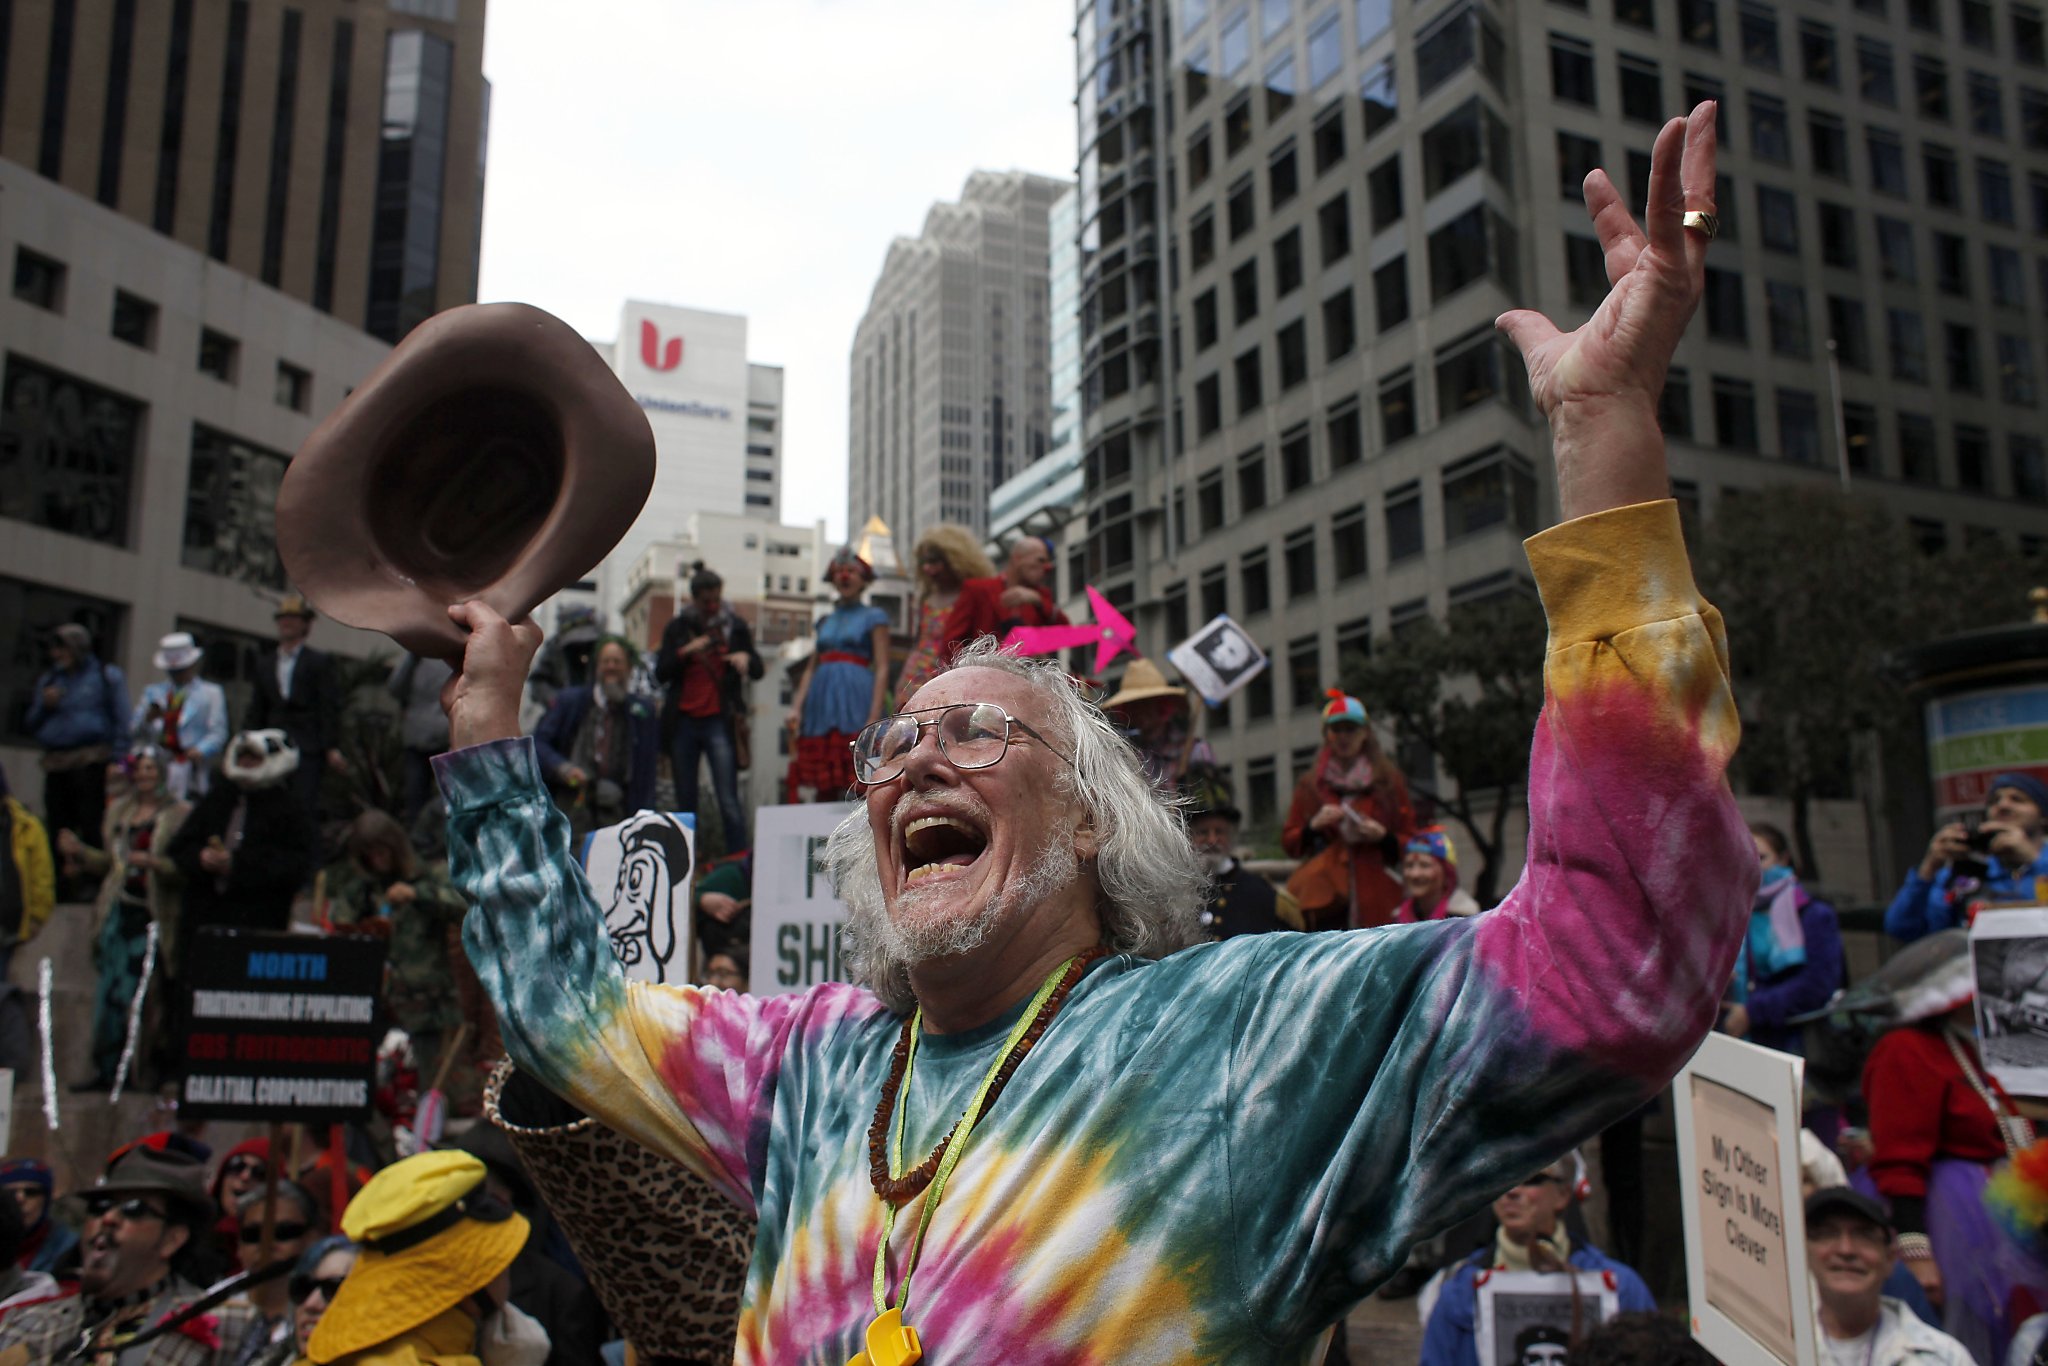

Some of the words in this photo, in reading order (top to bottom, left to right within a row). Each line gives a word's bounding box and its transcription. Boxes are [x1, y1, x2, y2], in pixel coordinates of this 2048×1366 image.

[248, 953, 327, 980] NORTH
[256, 1077, 367, 1107] CORPORATIONS
[1711, 1134, 1731, 1173] My
[1733, 1145, 1768, 1185] Other
[1702, 1167, 1733, 1209] Sign
[1735, 1184, 1748, 1215] Is
[1750, 1192, 1780, 1236] More
[1725, 1217, 1767, 1265] Clever
